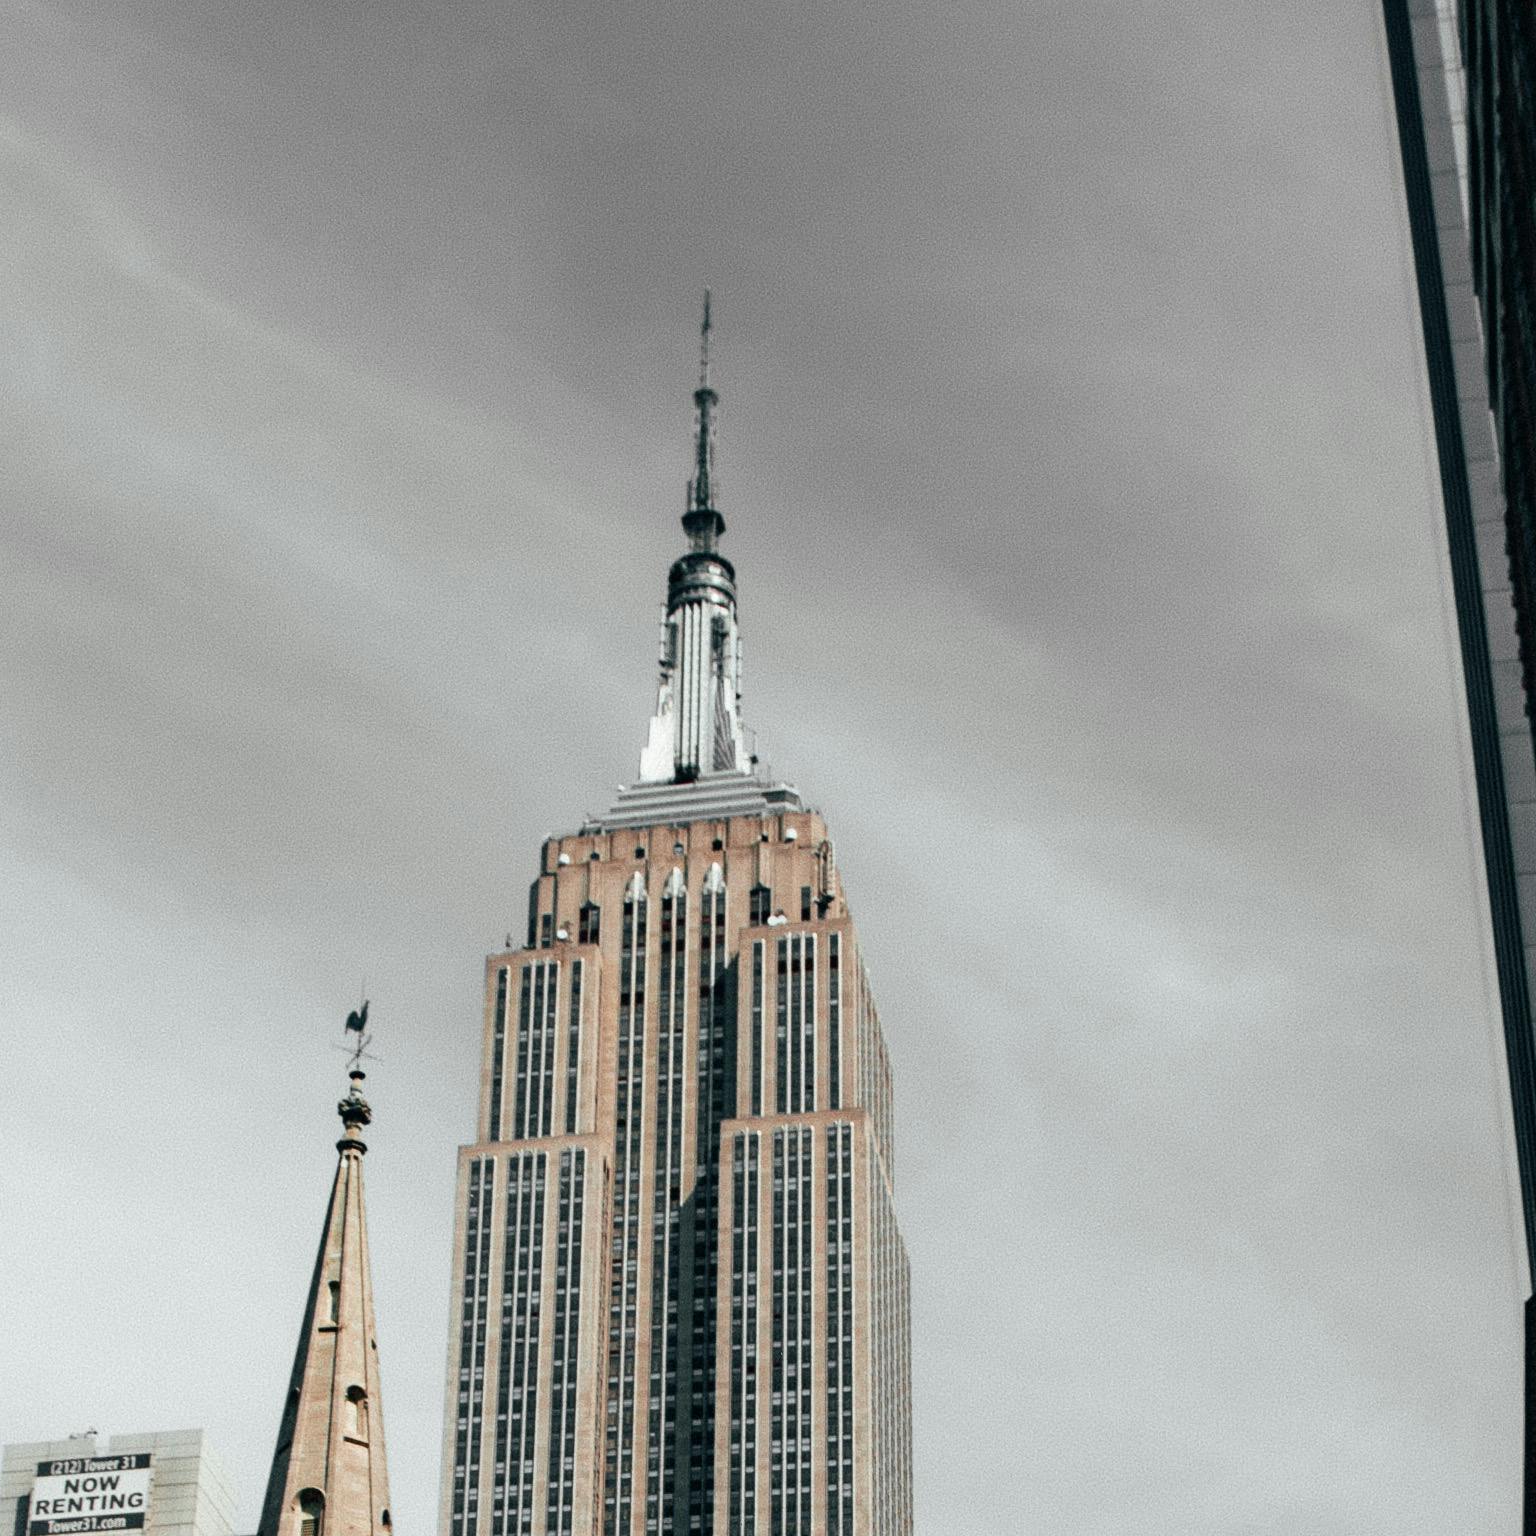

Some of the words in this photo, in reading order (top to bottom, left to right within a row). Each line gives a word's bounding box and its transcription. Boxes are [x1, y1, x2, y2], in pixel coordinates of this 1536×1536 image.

[51, 1460, 82, 1475] (212)
[84, 1459, 120, 1473] Tower
[122, 1456, 136, 1469] 31
[64, 1475, 120, 1494] NOW
[36, 1492, 144, 1515] RENTING
[48, 1517, 126, 1534] Tower31.com
